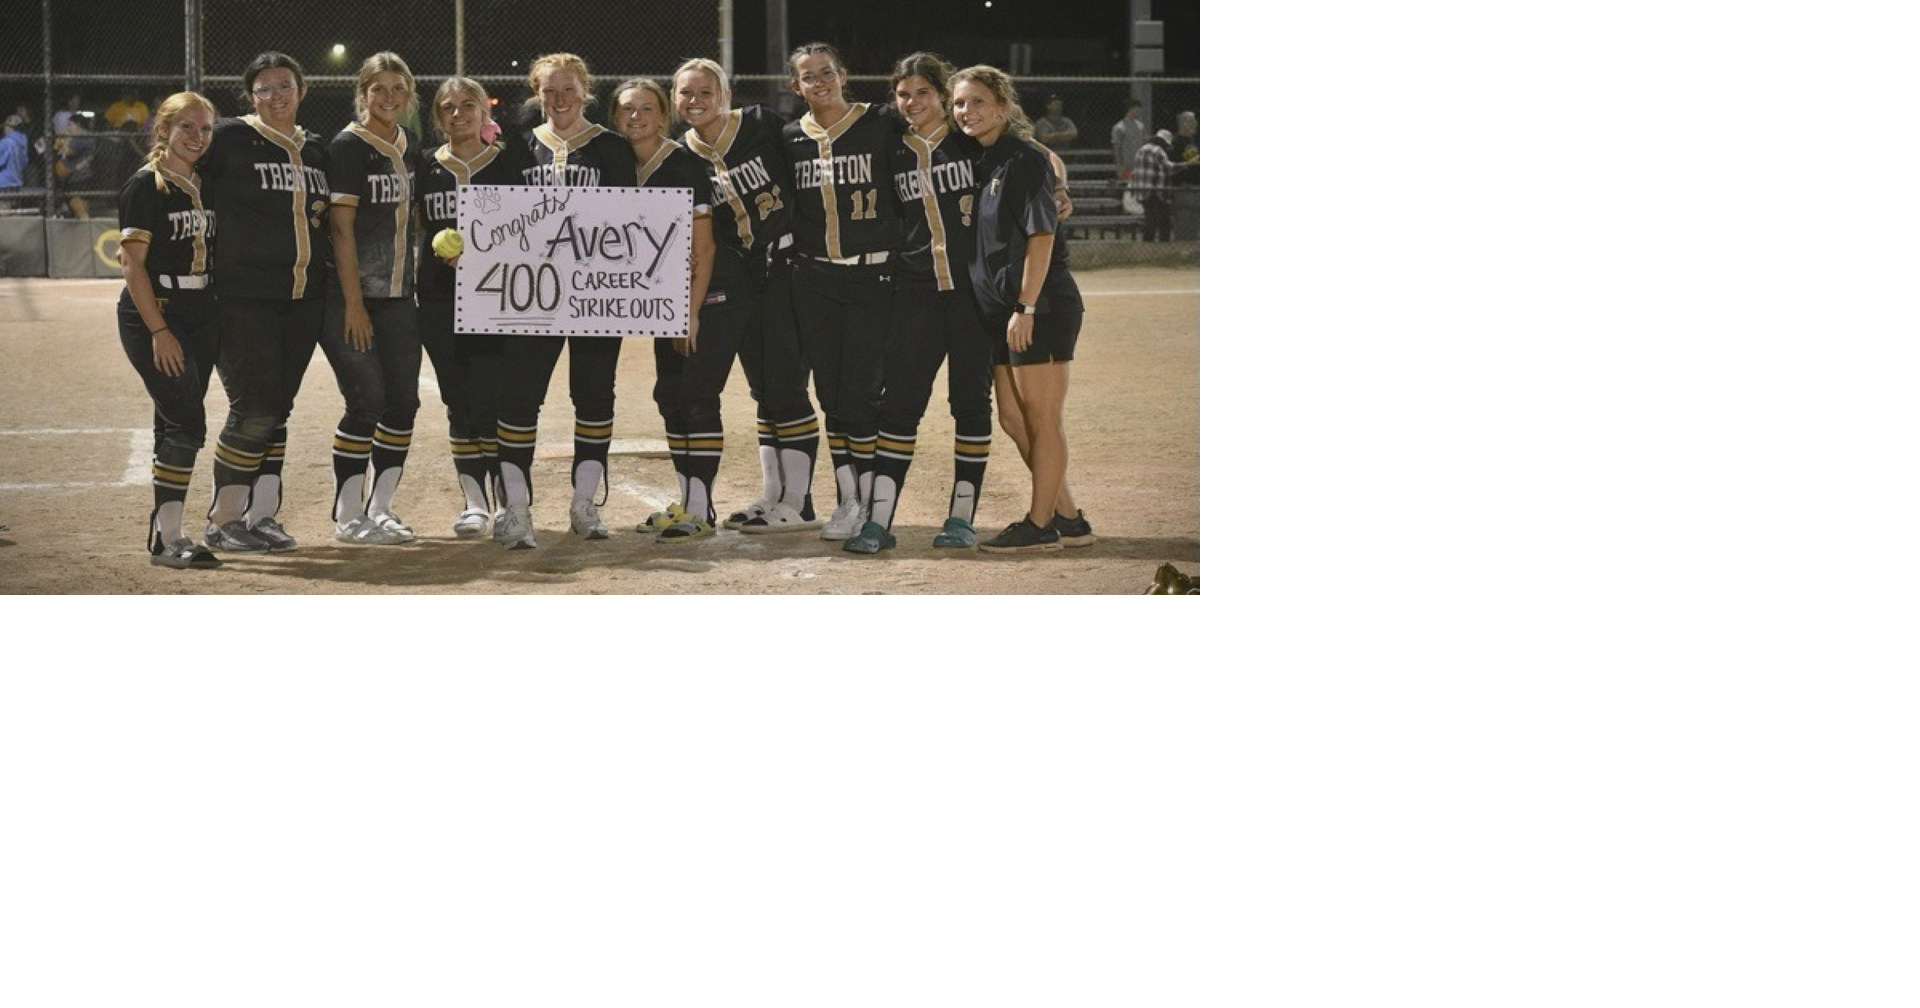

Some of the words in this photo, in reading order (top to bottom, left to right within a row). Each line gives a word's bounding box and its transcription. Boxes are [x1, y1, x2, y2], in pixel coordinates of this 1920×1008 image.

[795, 153, 872, 190] TRENTON
[470, 191, 571, 252] Congrats
[850, 188, 877, 219] 11
[546, 215, 678, 279] Avery
[475, 262, 561, 312] 400
[572, 270, 650, 291] CAREER
